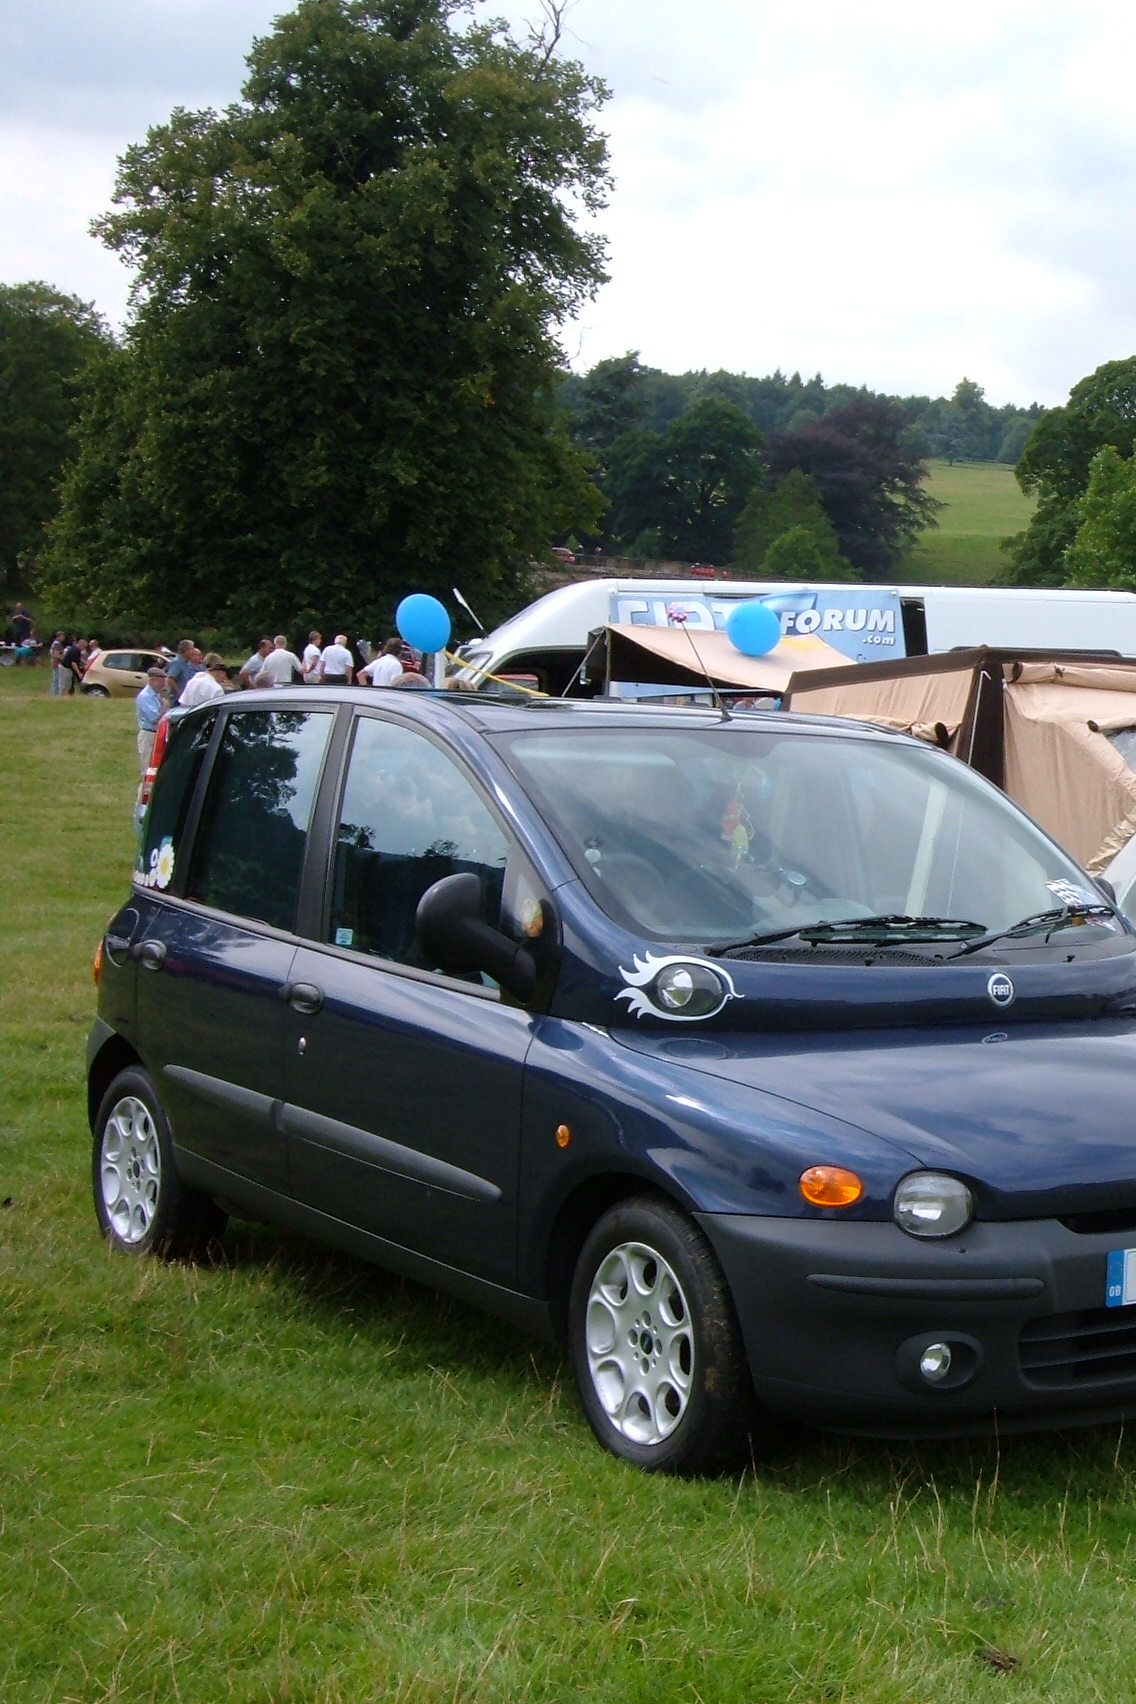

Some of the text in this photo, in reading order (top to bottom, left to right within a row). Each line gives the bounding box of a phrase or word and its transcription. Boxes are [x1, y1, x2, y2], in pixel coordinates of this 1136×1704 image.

[780, 608, 896, 635] FORUM
[862, 634, 895, 646] .com
[992, 984, 1010, 996] FIAT
[1108, 1284, 1122, 1297] GB
